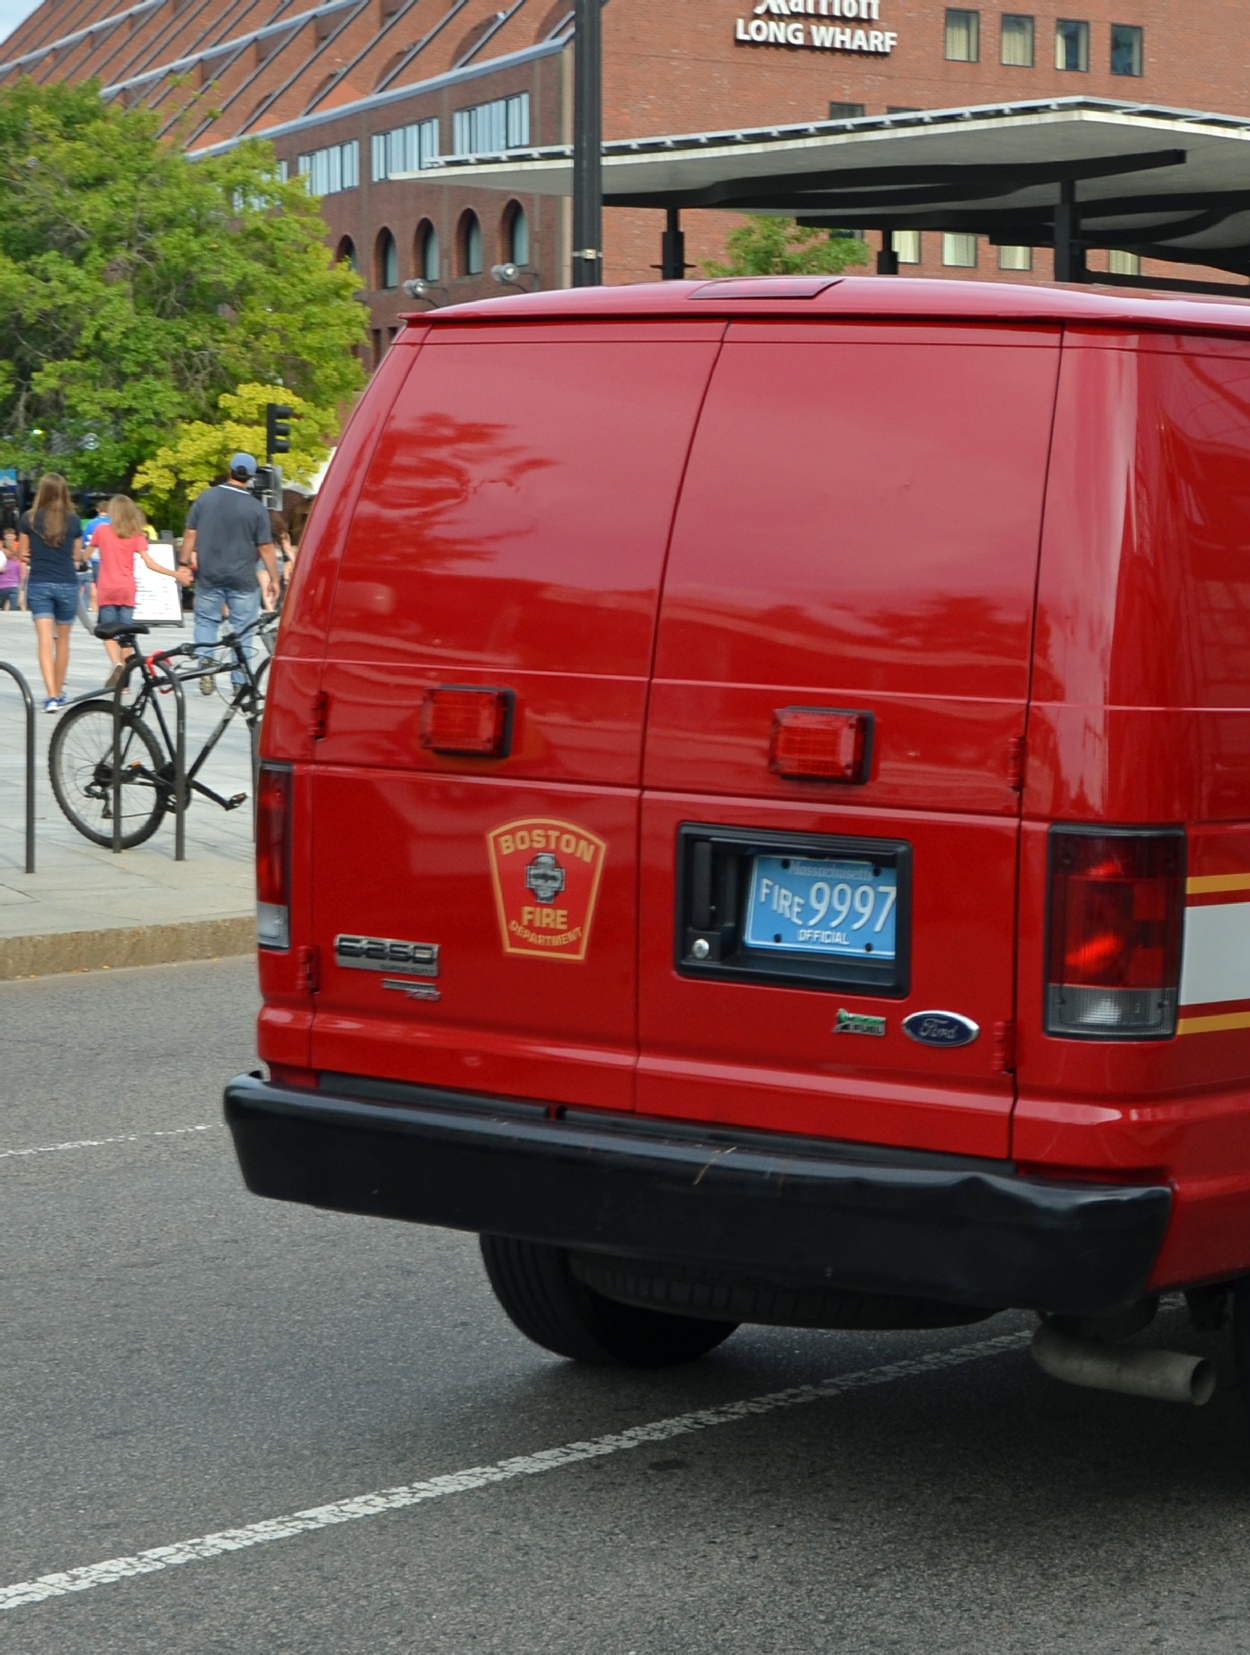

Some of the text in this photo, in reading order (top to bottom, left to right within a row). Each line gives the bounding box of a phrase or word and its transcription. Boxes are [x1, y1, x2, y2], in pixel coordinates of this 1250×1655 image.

[736, 18, 898, 53] LONG WHARF
[499, 829, 595, 863] BOSTON
[788, 862, 874, 881] Massachusetts
[521, 906, 568, 930] FIRE
[759, 878, 897, 933] FIRE 9997
[508, 919, 583, 946] DEPARTMENT
[797, 928, 850, 945] OFFICIAL
[919, 1017, 959, 1039] Ford
